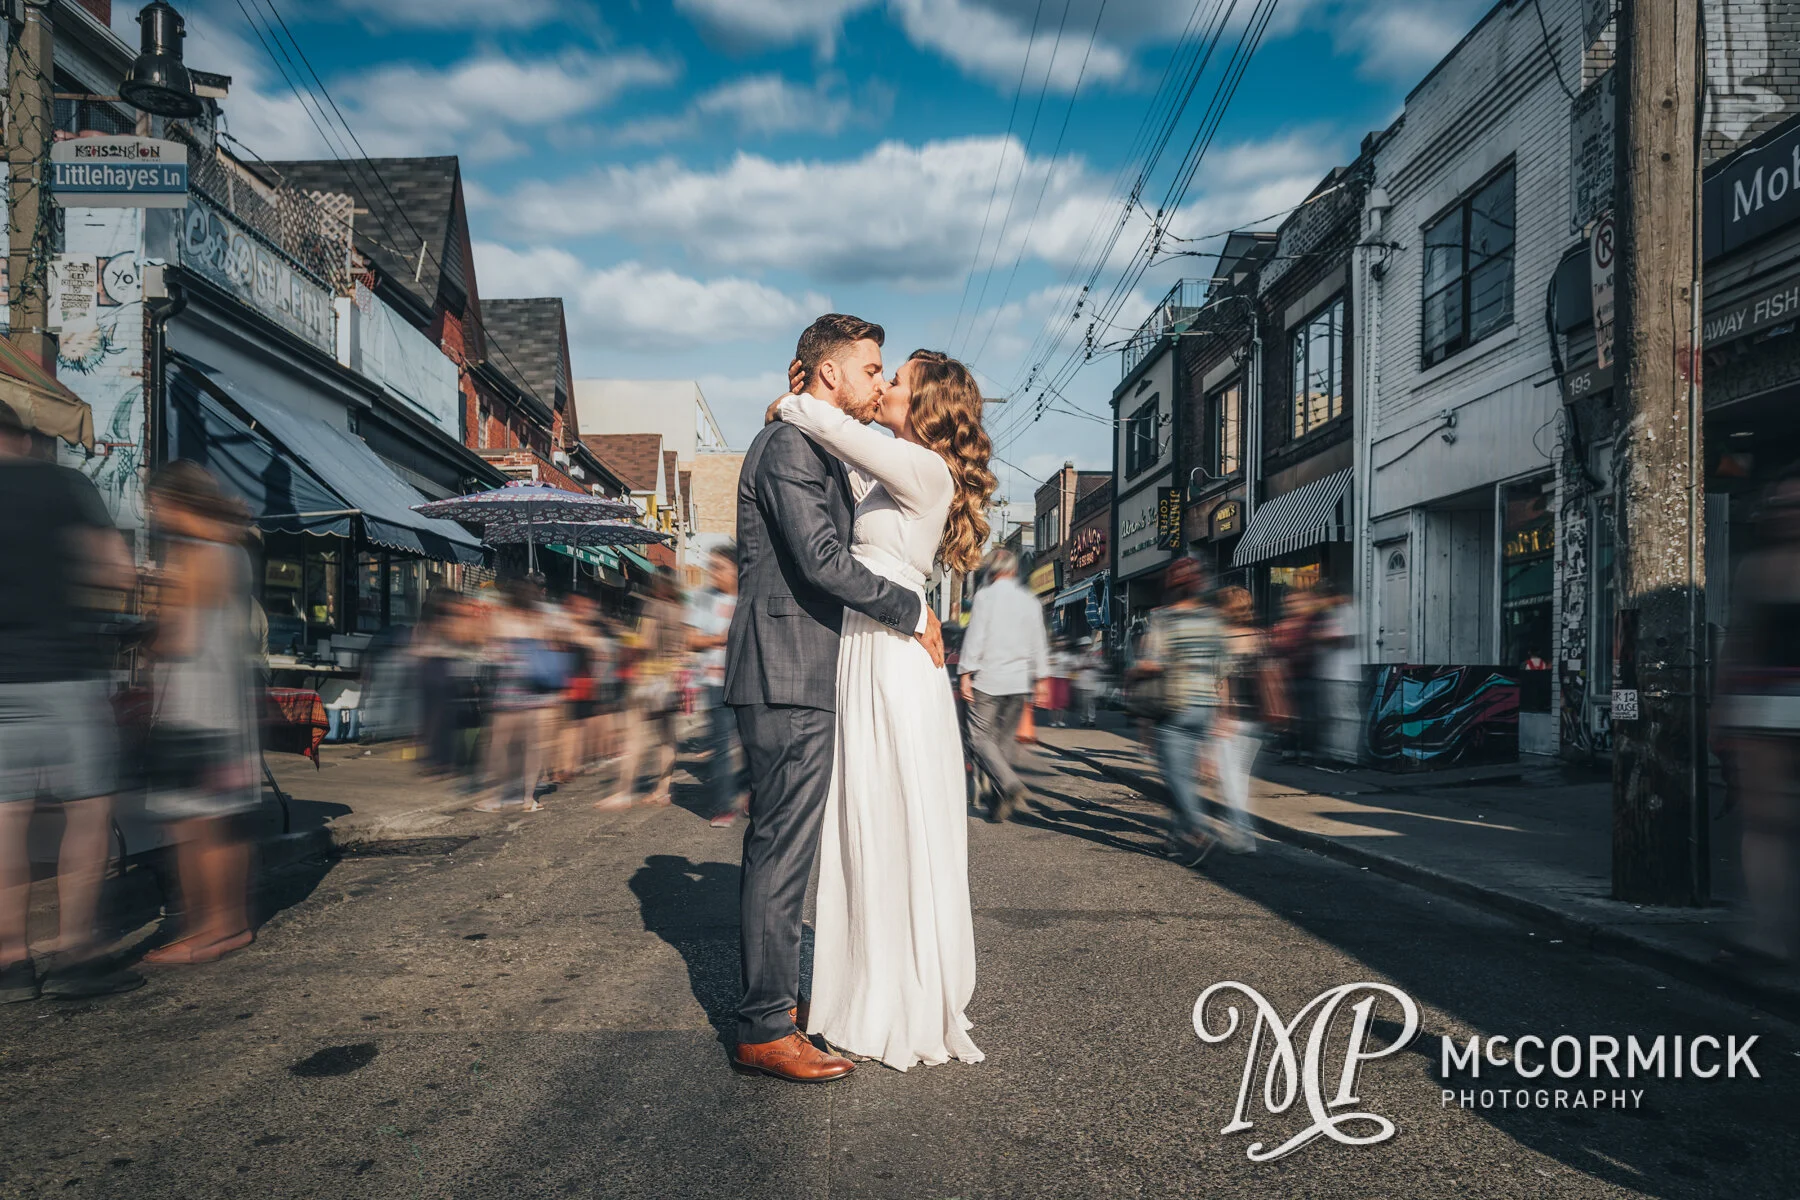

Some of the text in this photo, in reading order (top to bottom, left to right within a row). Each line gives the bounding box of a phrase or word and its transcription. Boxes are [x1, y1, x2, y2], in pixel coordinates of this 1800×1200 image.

[55, 164, 180, 191] Littlehayes Ln
[1753, 287, 1799, 324] FISH
[1569, 372, 1591, 396] 195
[1160, 499, 1168, 536] COFFEE
[1169, 489, 1181, 548] JIMMY'S
[1623, 691, 1637, 703] 12
